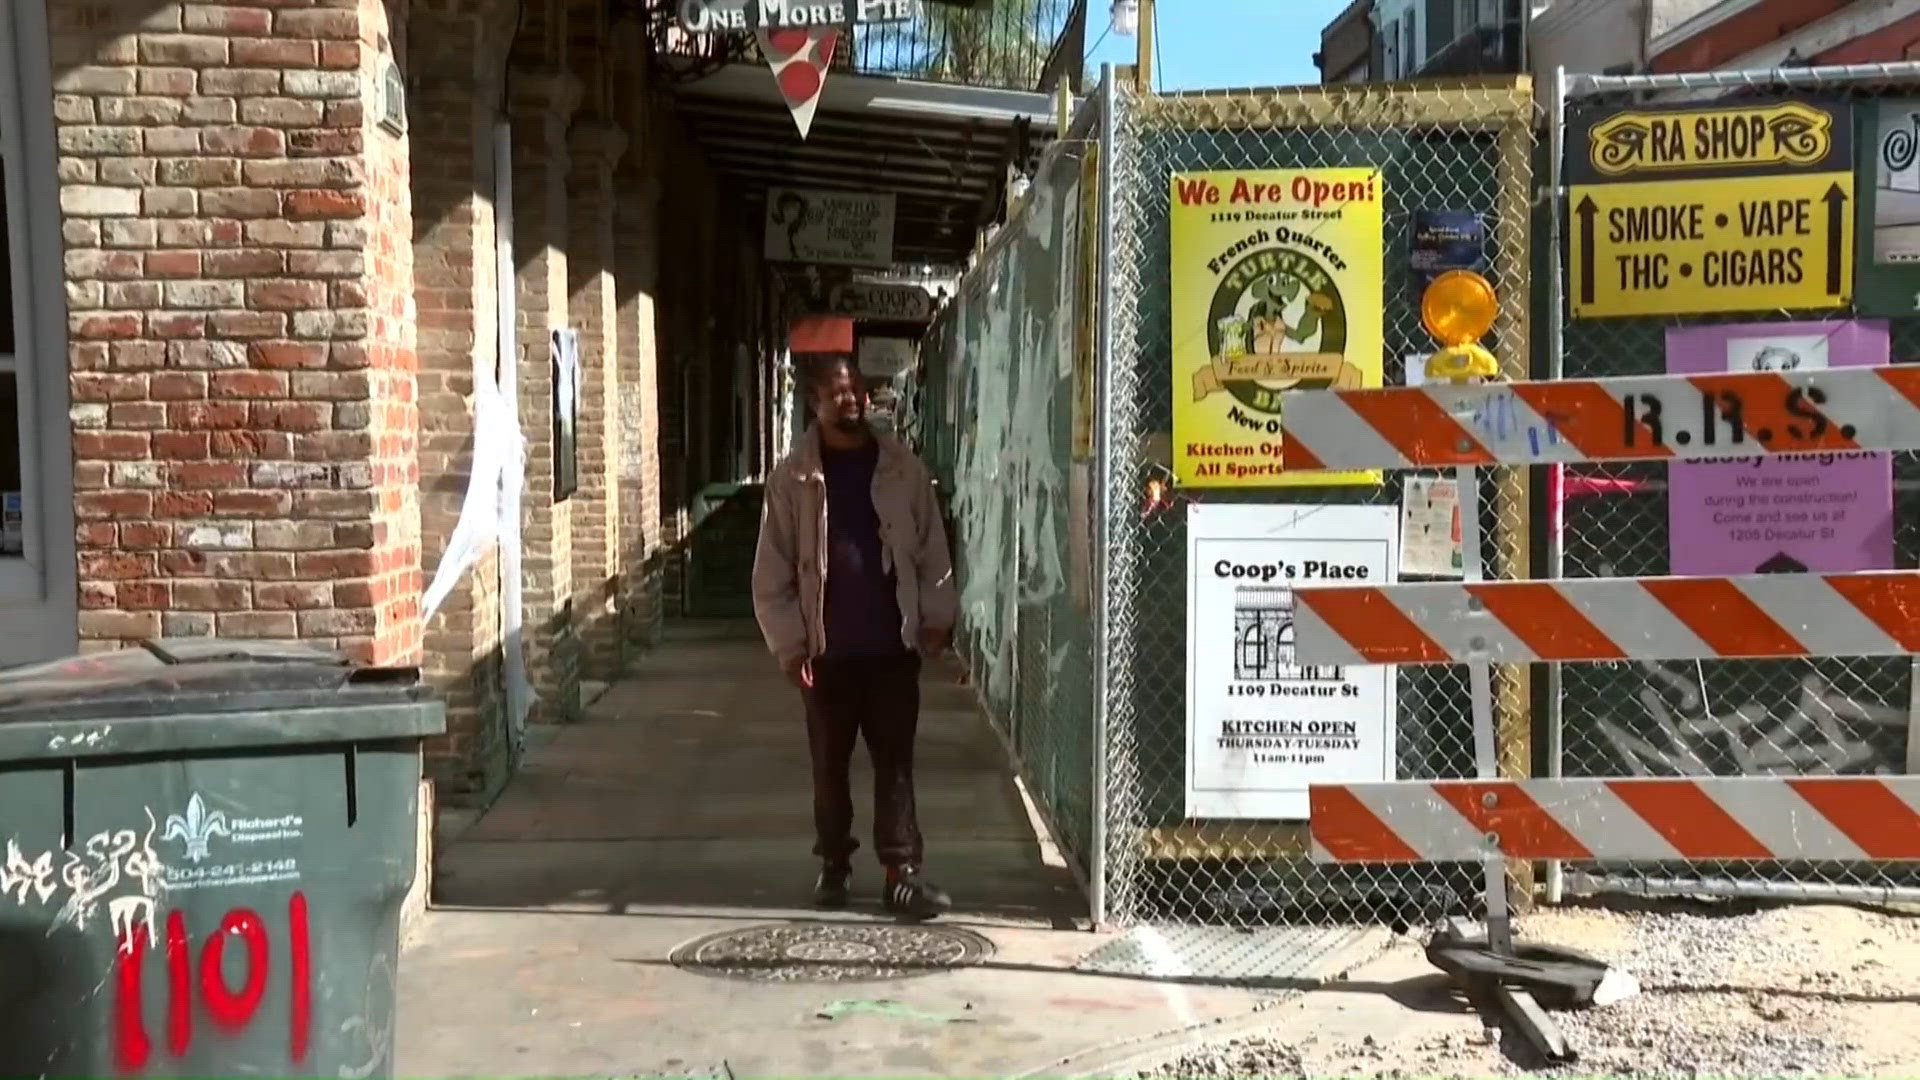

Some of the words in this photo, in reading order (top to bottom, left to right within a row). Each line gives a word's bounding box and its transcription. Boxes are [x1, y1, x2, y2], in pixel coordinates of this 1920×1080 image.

[681, 0, 747, 31] ONE
[758, 0, 846, 27] MORE
[856, 0, 912, 21] PIE
[1650, 119, 1686, 163] RA
[1694, 114, 1767, 160] SHOP
[1176, 178, 1220, 206] We
[1230, 177, 1281, 204] Are
[1210, 212, 1241, 223] 1119
[1245, 209, 1299, 222] Decatur
[1301, 208, 1343, 220] Street
[1608, 203, 1705, 244] SMOKE
[1739, 198, 1812, 238] VAPE
[1207, 228, 1270, 277] French
[1275, 226, 1348, 273] Quarter
[1226, 251, 1330, 292] TURTLE
[1616, 253, 1670, 290] THC
[1703, 247, 1805, 288] CIGARS
[1228, 360, 1260, 376] Food
[1277, 358, 1328, 377] Spirits
[1227, 405, 1264, 432] New
[1623, 386, 1858, 447] R.R.S.
[1186, 443, 1255, 457] Kitchen
[1260, 442, 1282, 459] Op
[1195, 463, 1220, 476] All
[1226, 461, 1283, 478] Sports
[1736, 476, 1758, 488] We
[1761, 477, 1783, 488] are
[1786, 476, 1821, 490] open
[1703, 497, 1745, 508] during
[1748, 494, 1769, 505] the
[1772, 491, 1858, 504] construction!
[1712, 512, 1753, 524] Come
[1756, 511, 1781, 523] and
[1785, 512, 1809, 523] see
[1812, 512, 1829, 522] us
[1832, 510, 1847, 521] at
[1764, 528, 1817, 541] Decatur
[1821, 527, 1836, 540] St
[1213, 560, 1297, 583] Coop's
[1302, 560, 1369, 580] Place
[1226, 684, 1266, 698] 1109
[1270, 684, 1337, 697] Decatur
[1342, 684, 1359, 697] St
[1221, 720, 1303, 734] KITCHEN
[1308, 719, 1357, 734] OPEN
[231, 814, 303, 830] Richard's
[231, 829, 282, 843] Disposal
